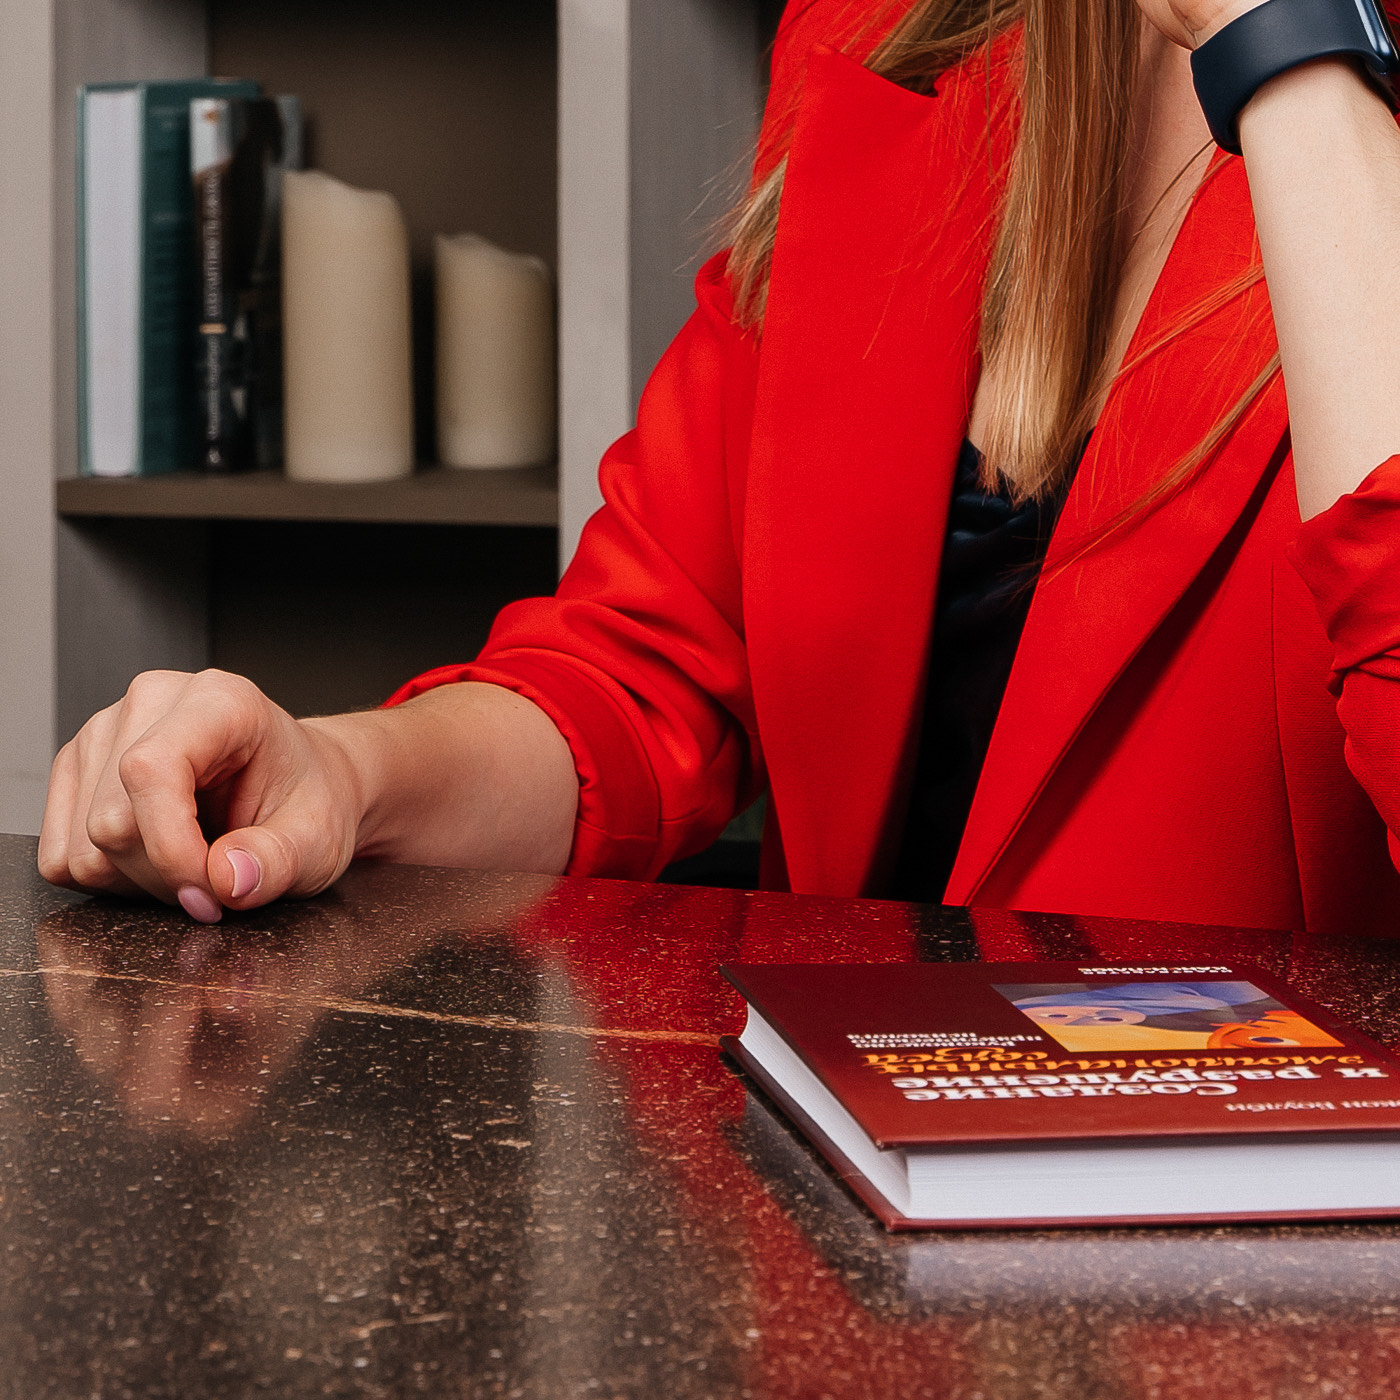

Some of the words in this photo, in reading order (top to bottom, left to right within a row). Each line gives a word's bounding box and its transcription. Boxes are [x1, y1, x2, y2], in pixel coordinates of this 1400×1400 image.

[859, 1046, 1050, 1066] связей
[870, 1054, 1365, 1075] эмоциональных
[890, 1066, 1323, 1090] разрушение
[1333, 1067, 1390, 1079] и
[902, 1082, 1239, 1101] Создание
[1223, 1100, 1338, 1113] Боулби
